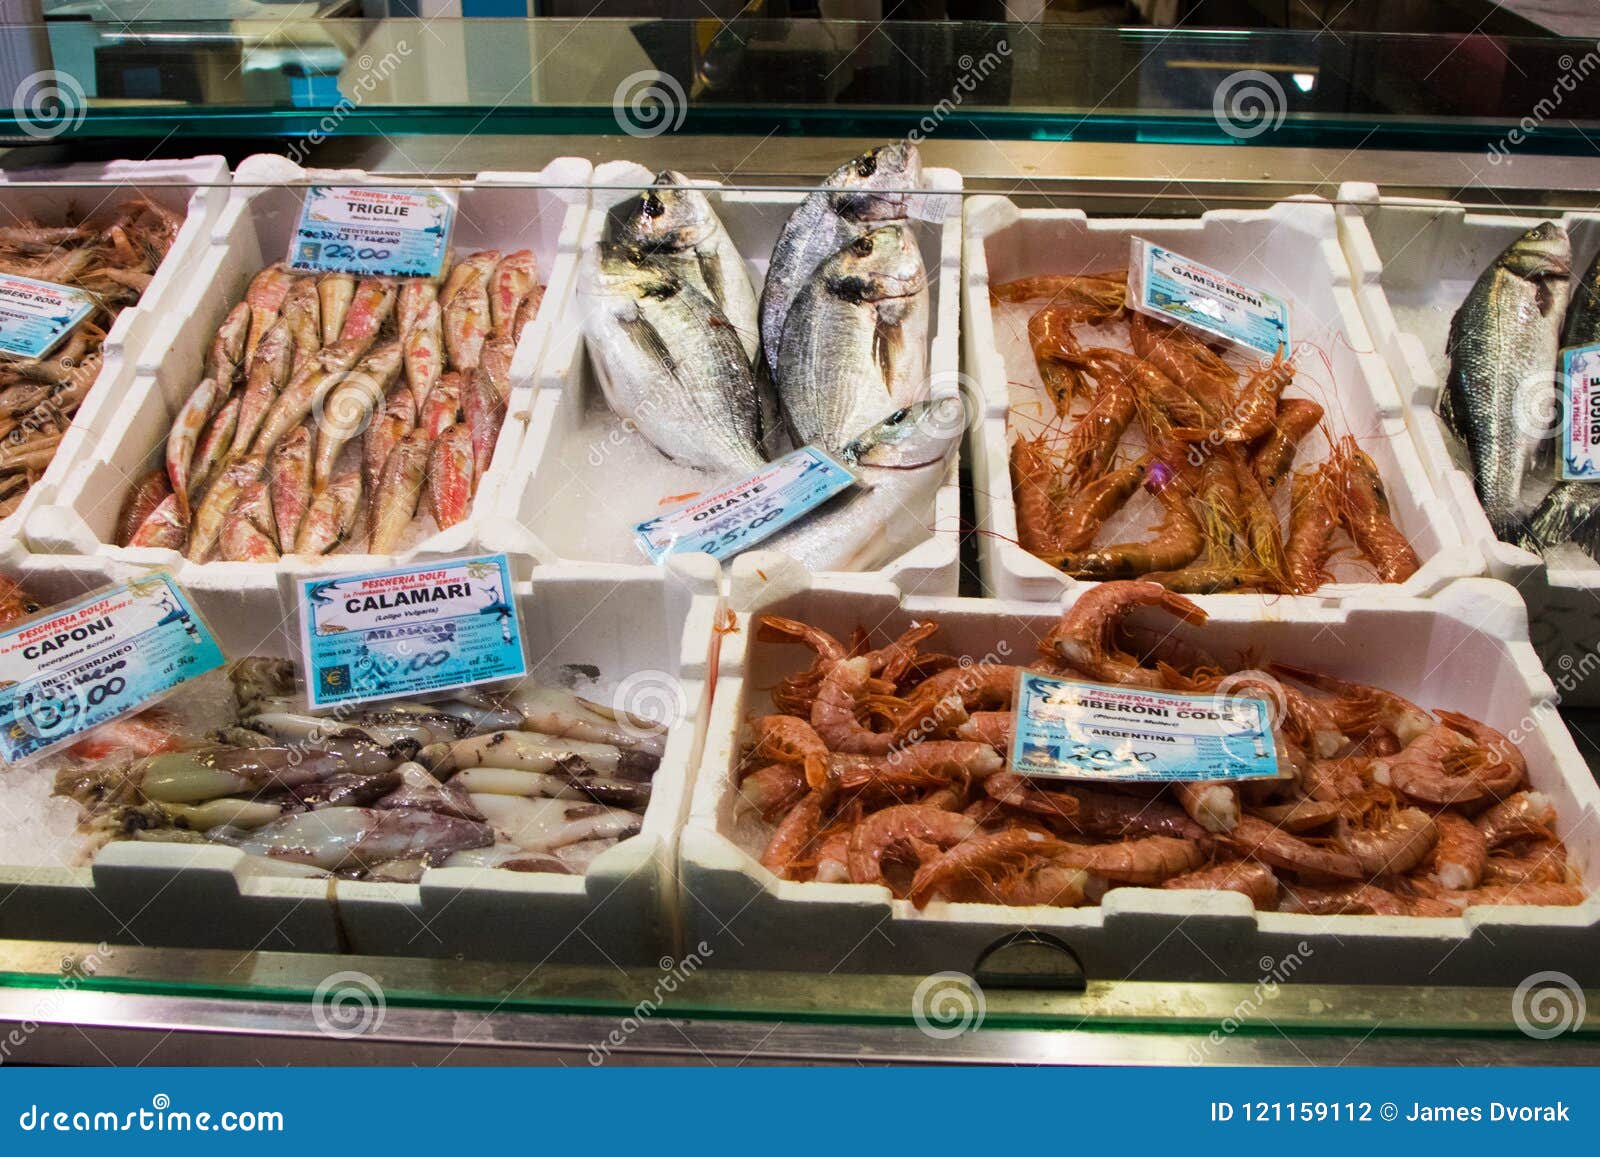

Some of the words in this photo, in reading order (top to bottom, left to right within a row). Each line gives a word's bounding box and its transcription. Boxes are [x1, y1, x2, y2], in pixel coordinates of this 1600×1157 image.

[347, 202, 410, 217] TRIGLIE
[1171, 266, 1263, 308] GAMBERONI
[692, 484, 767, 522] ORATE
[362, 575, 416, 588] PESCHERIA
[418, 571, 447, 581] DOLFI
[345, 583, 473, 614] CALAMARI
[18, 614, 77, 641] PESCHERIA
[79, 600, 110, 618] DOLFI
[22, 616, 114, 660] CAPONI
[41, 645, 133, 688] MEDITERRANEO
[1176, 703, 1235, 722] CODE
[1091, 728, 1176, 744] ARGENTINA
